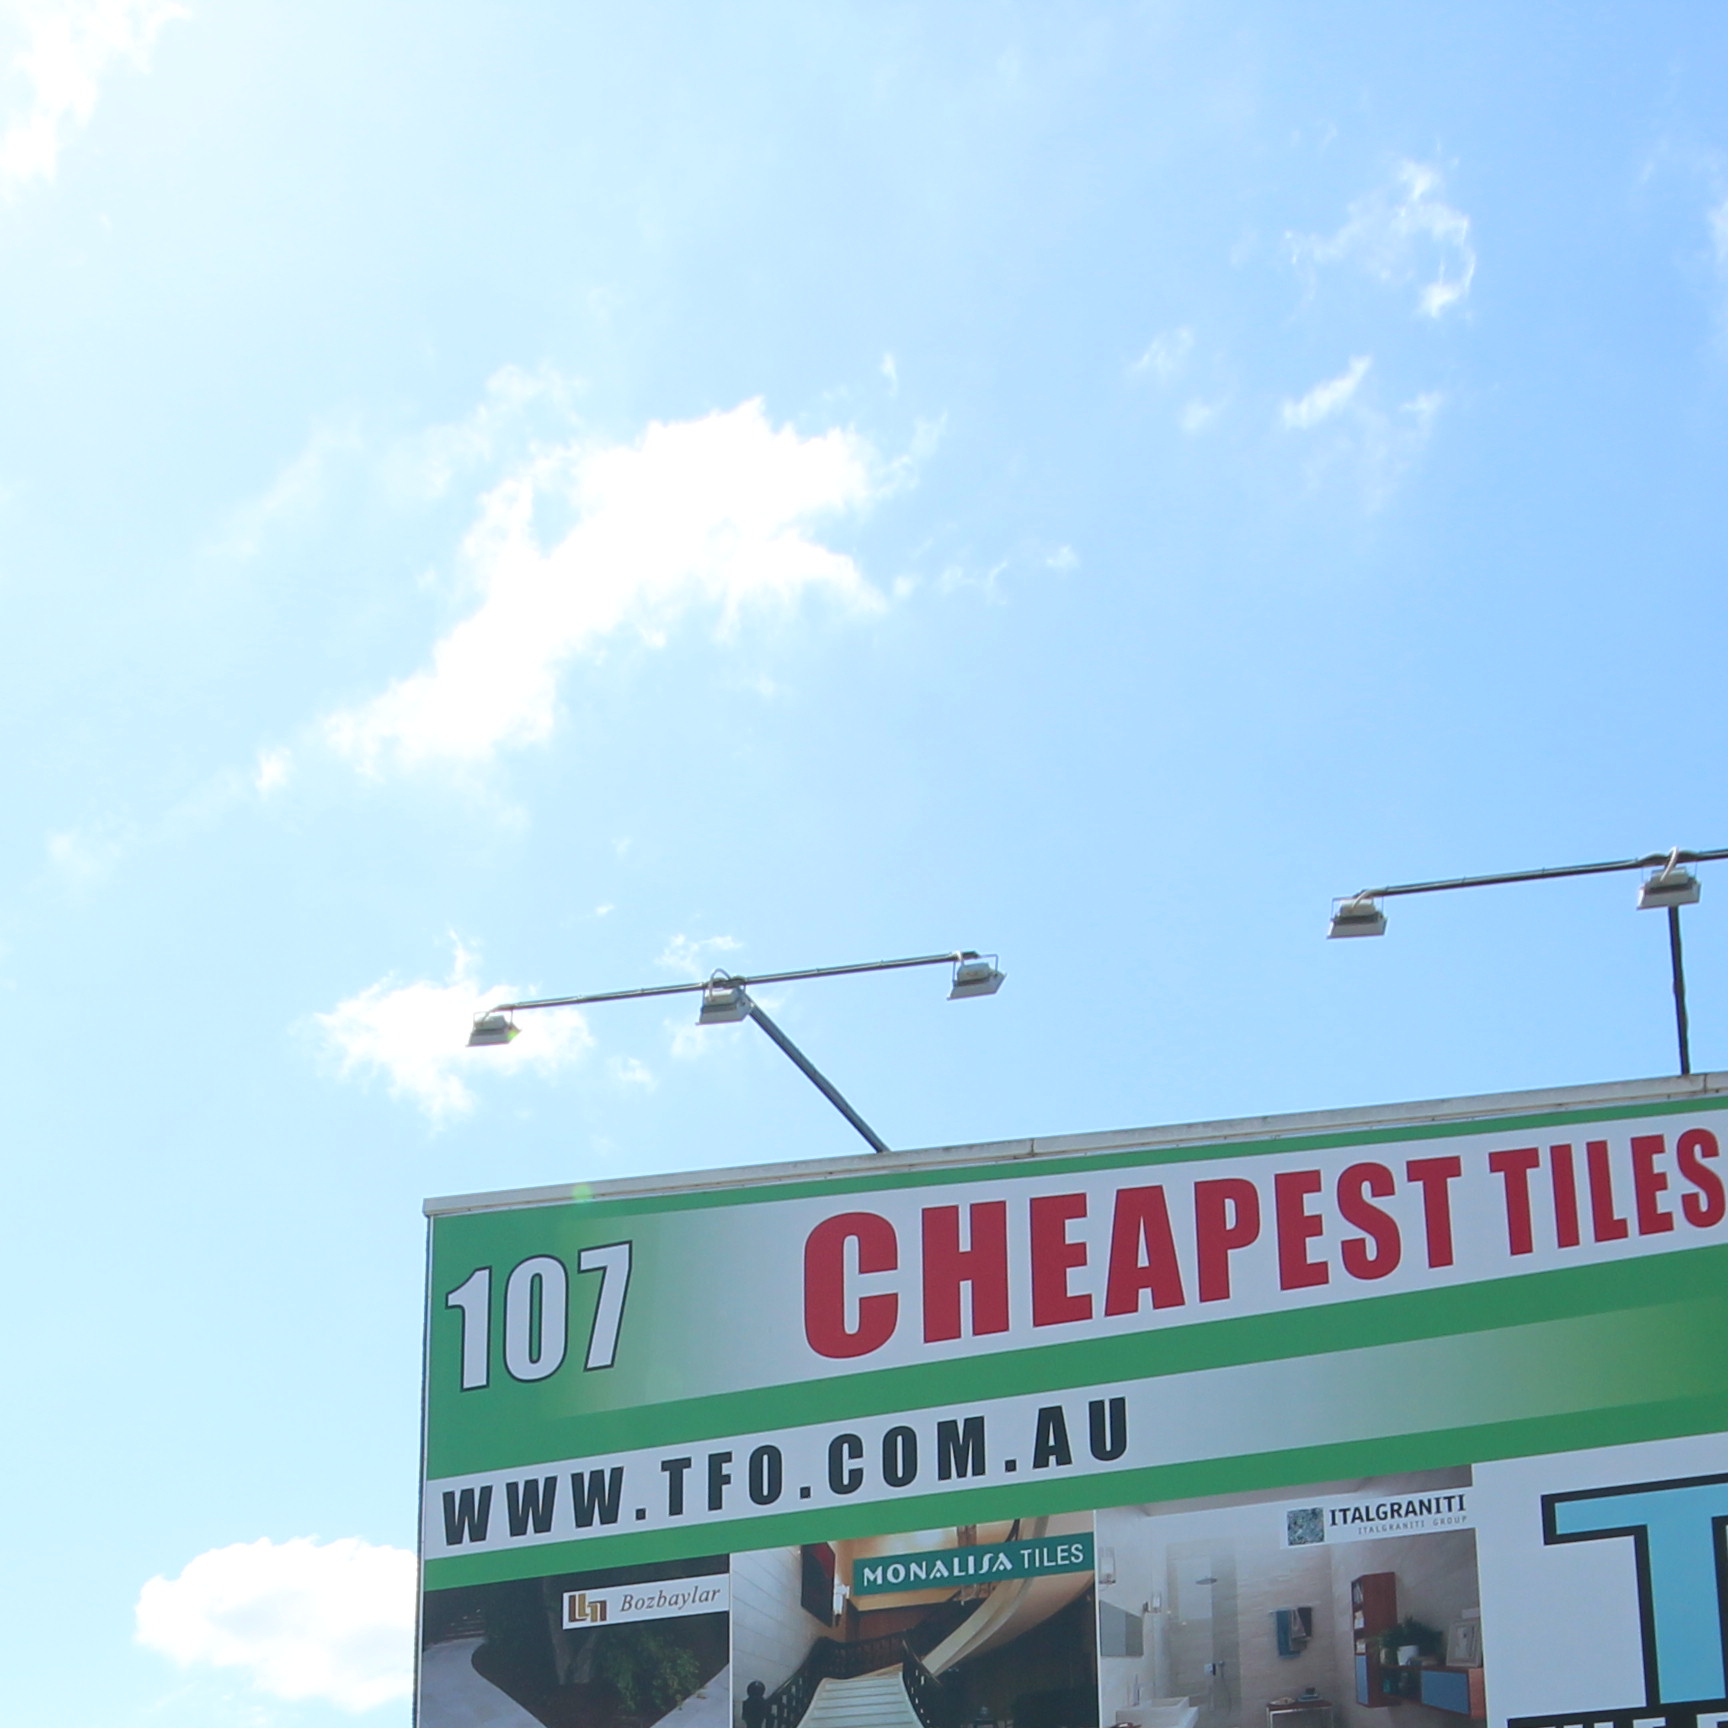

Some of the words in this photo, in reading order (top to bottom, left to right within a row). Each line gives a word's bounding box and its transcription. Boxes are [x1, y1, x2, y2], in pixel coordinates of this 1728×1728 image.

[803, 1155, 1462, 1359] CHEAPEST
[1489, 1127, 1725, 1257] TILES
[444, 1240, 632, 1393] 107
[441, 1396, 1129, 1546] WWW.TFO.COM.AU
[1330, 1494, 1467, 1526] ITALGRANITI
[1358, 1521, 1425, 1535] ITALGRANITI
[1433, 1516, 1467, 1526] GROUP
[863, 1552, 1013, 1587] MONALISA
[1020, 1543, 1084, 1569] TILES
[619, 1585, 721, 1612] Bozbaylar
